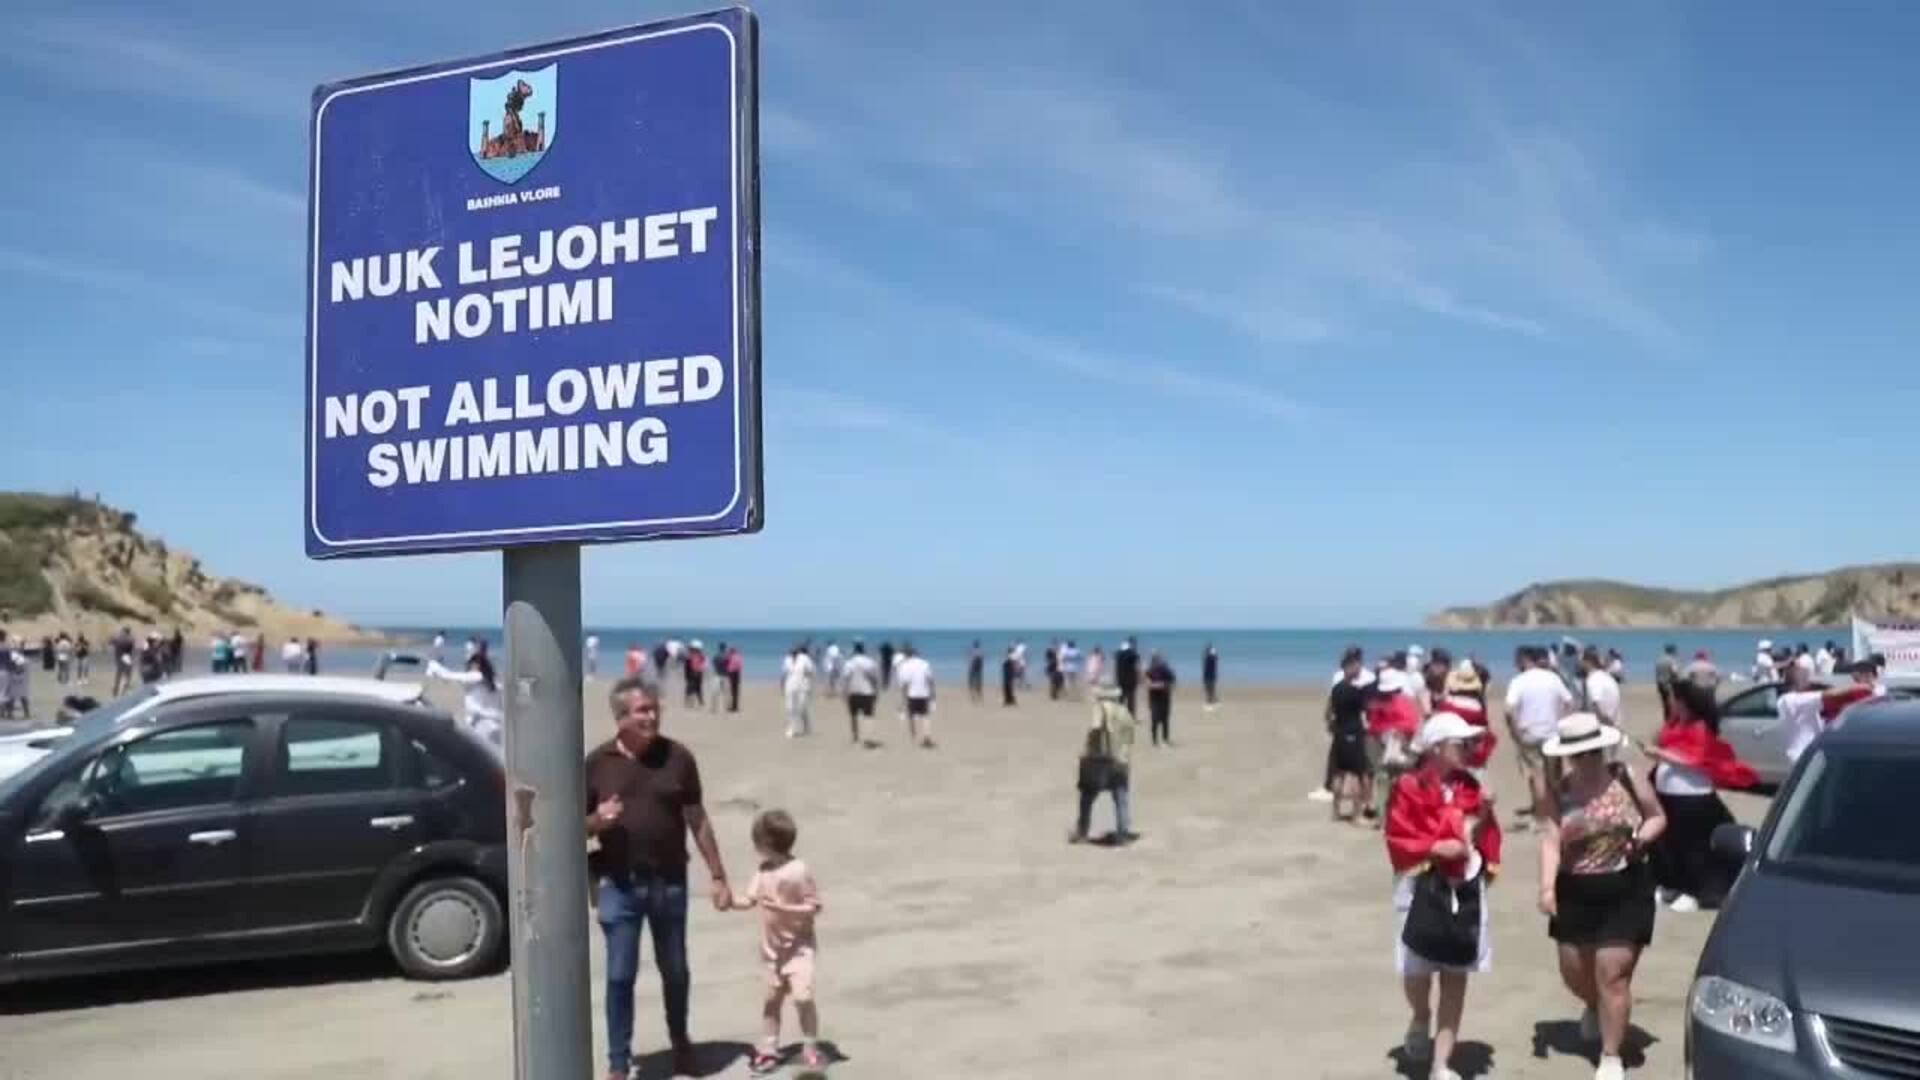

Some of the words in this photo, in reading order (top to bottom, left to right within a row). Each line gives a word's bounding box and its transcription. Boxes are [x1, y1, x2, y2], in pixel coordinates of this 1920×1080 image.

[520, 186, 561, 203] VLORE
[331, 246, 444, 303] NUK
[458, 206, 718, 285] LEJOHET
[415, 276, 613, 345] NOTIMI
[324, 385, 431, 439] NOT
[444, 354, 724, 427] ALLOWED
[367, 416, 668, 488] SWIMMING
